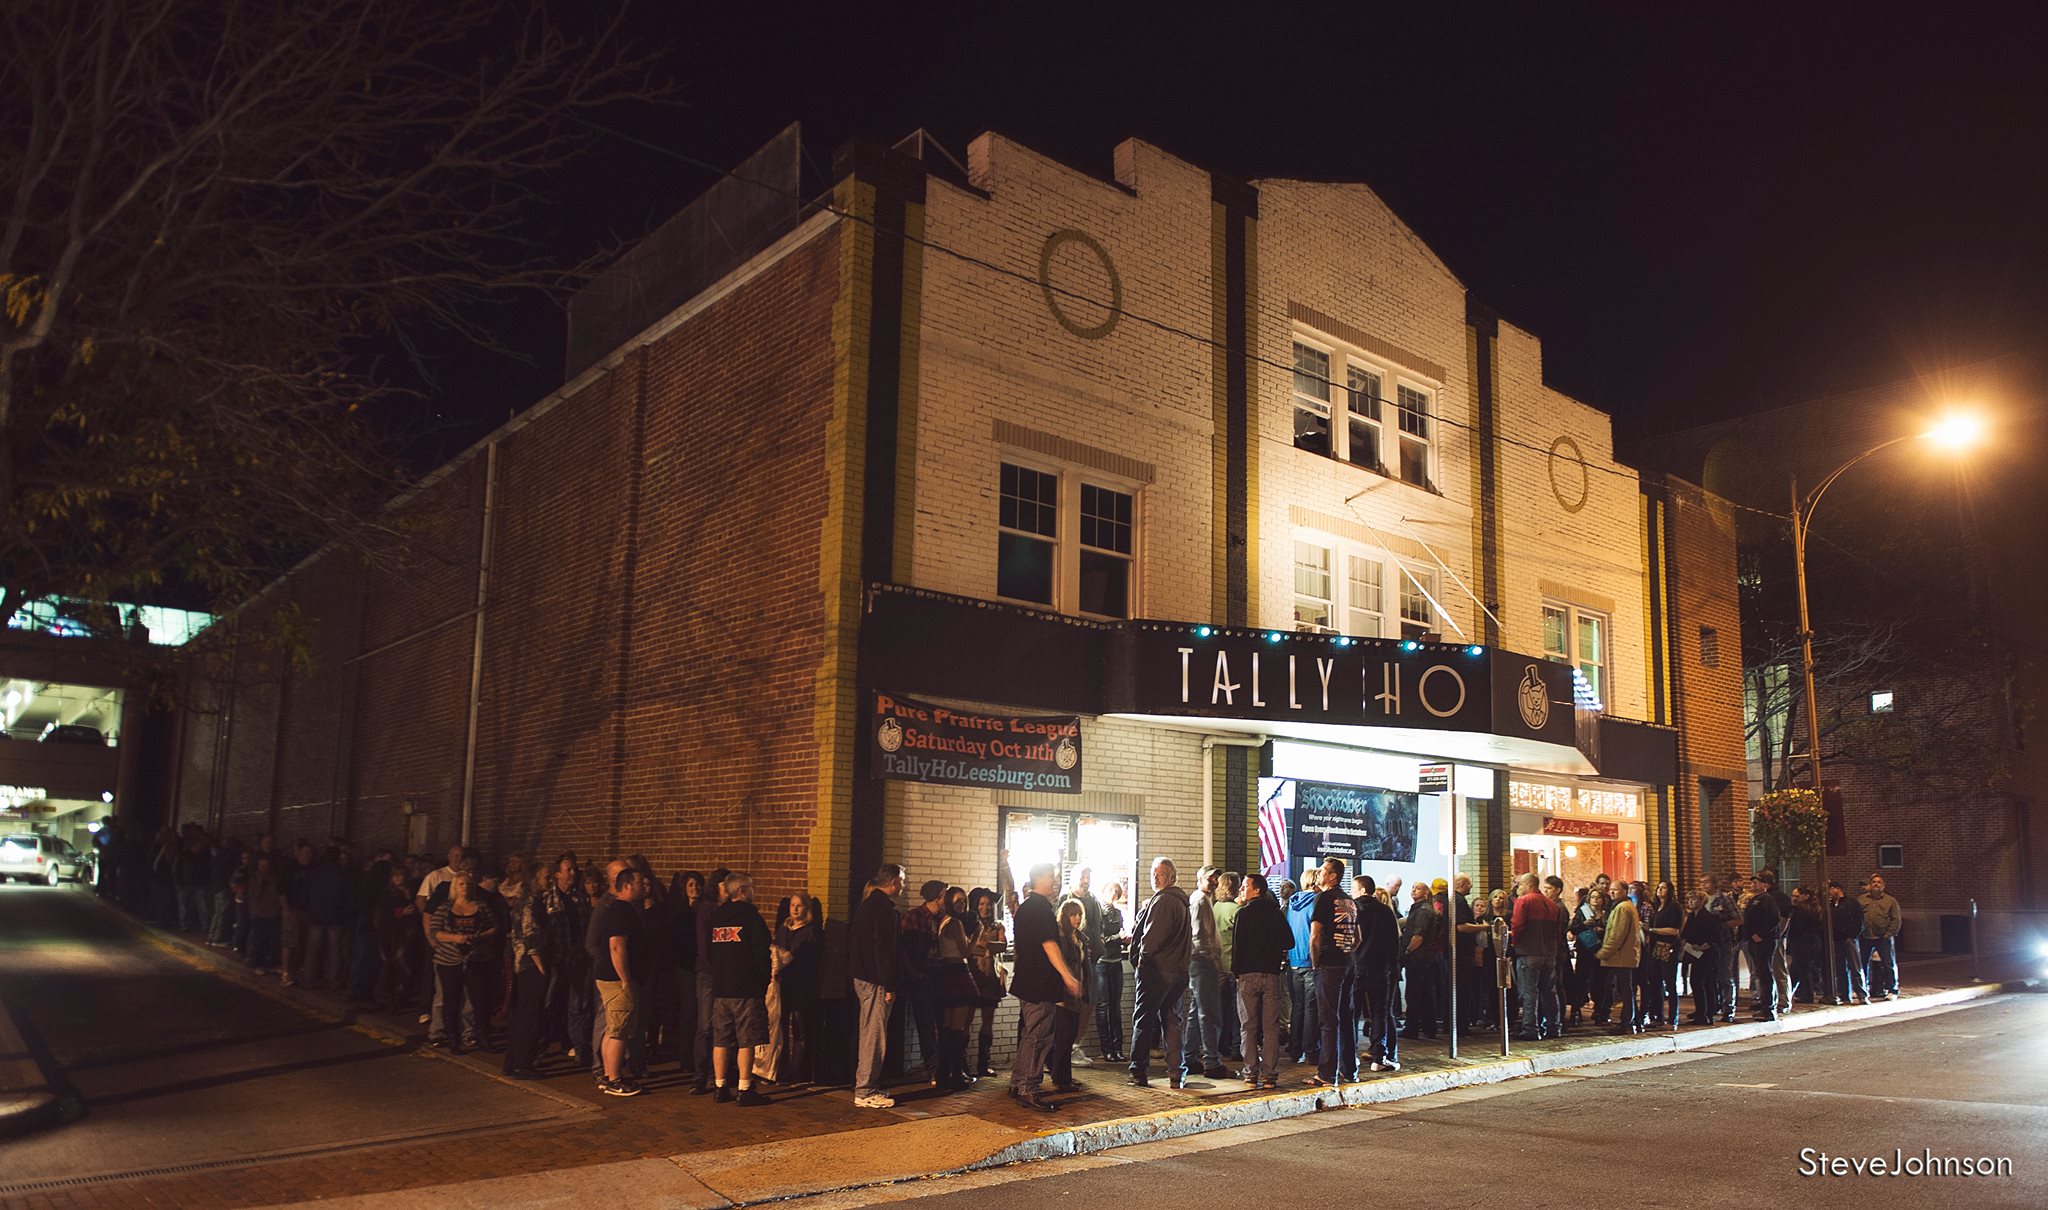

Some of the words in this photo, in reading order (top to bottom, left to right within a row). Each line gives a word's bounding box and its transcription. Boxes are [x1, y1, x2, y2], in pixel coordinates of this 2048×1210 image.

[1178, 647, 1334, 711] TALLY
[1374, 662, 1466, 718] HO
[877, 695, 928, 721] Pure
[933, 708, 1004, 732] Prairie
[1009, 718, 1078, 741] League
[903, 728, 987, 760] Saturday
[990, 739, 1022, 758] Oct
[1024, 743, 1054, 761] 11th
[883, 753, 1072, 790] TallyHoLeesburg.com
